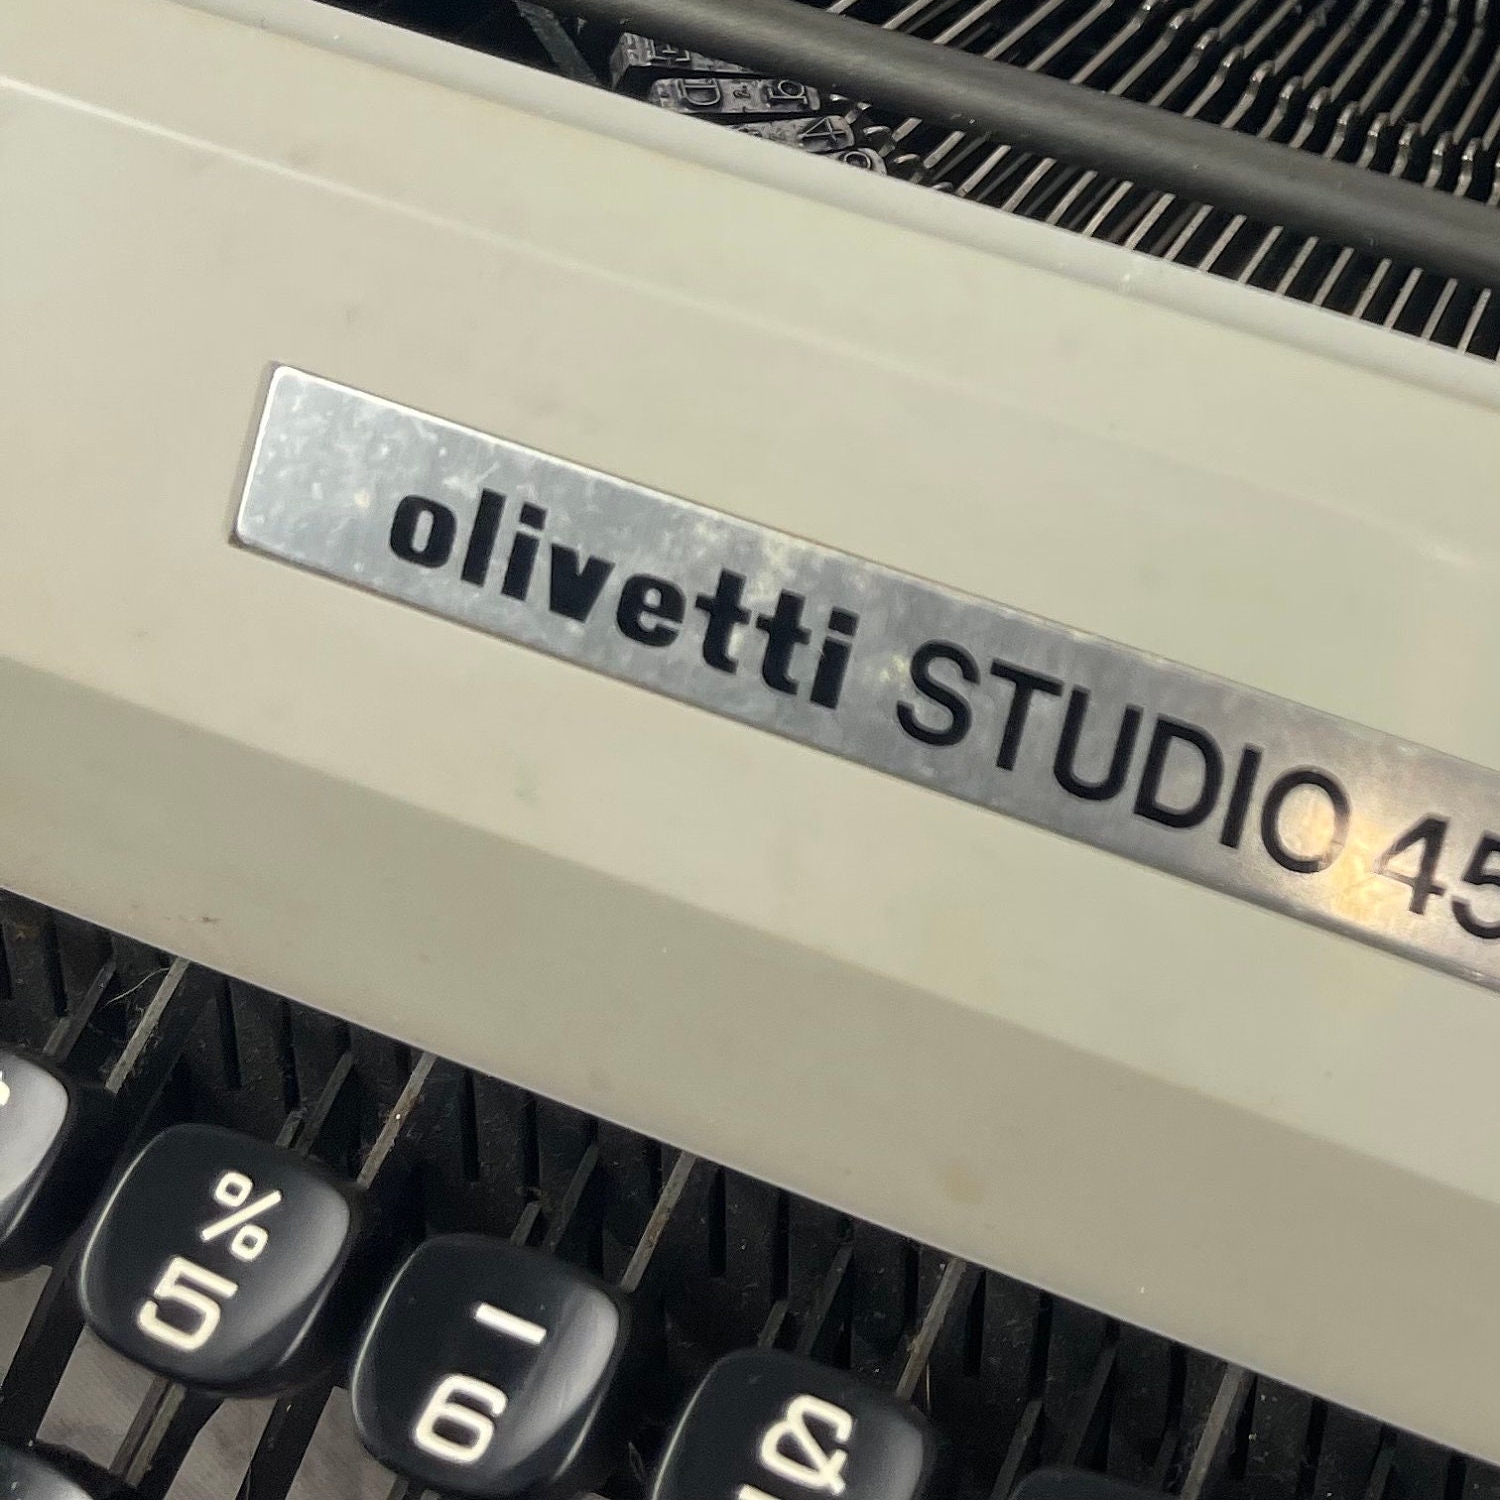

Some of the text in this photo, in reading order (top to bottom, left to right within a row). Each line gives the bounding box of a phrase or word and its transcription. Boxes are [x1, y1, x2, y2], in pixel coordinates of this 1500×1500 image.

[389, 488, 861, 710] olivetti
[896, 639, 1353, 875] STUDIO
[200, 1170, 283, 1263] %
[136, 1255, 239, 1351] 5
[413, 1372, 508, 1464] 6
[759, 1394, 854, 1497] &
